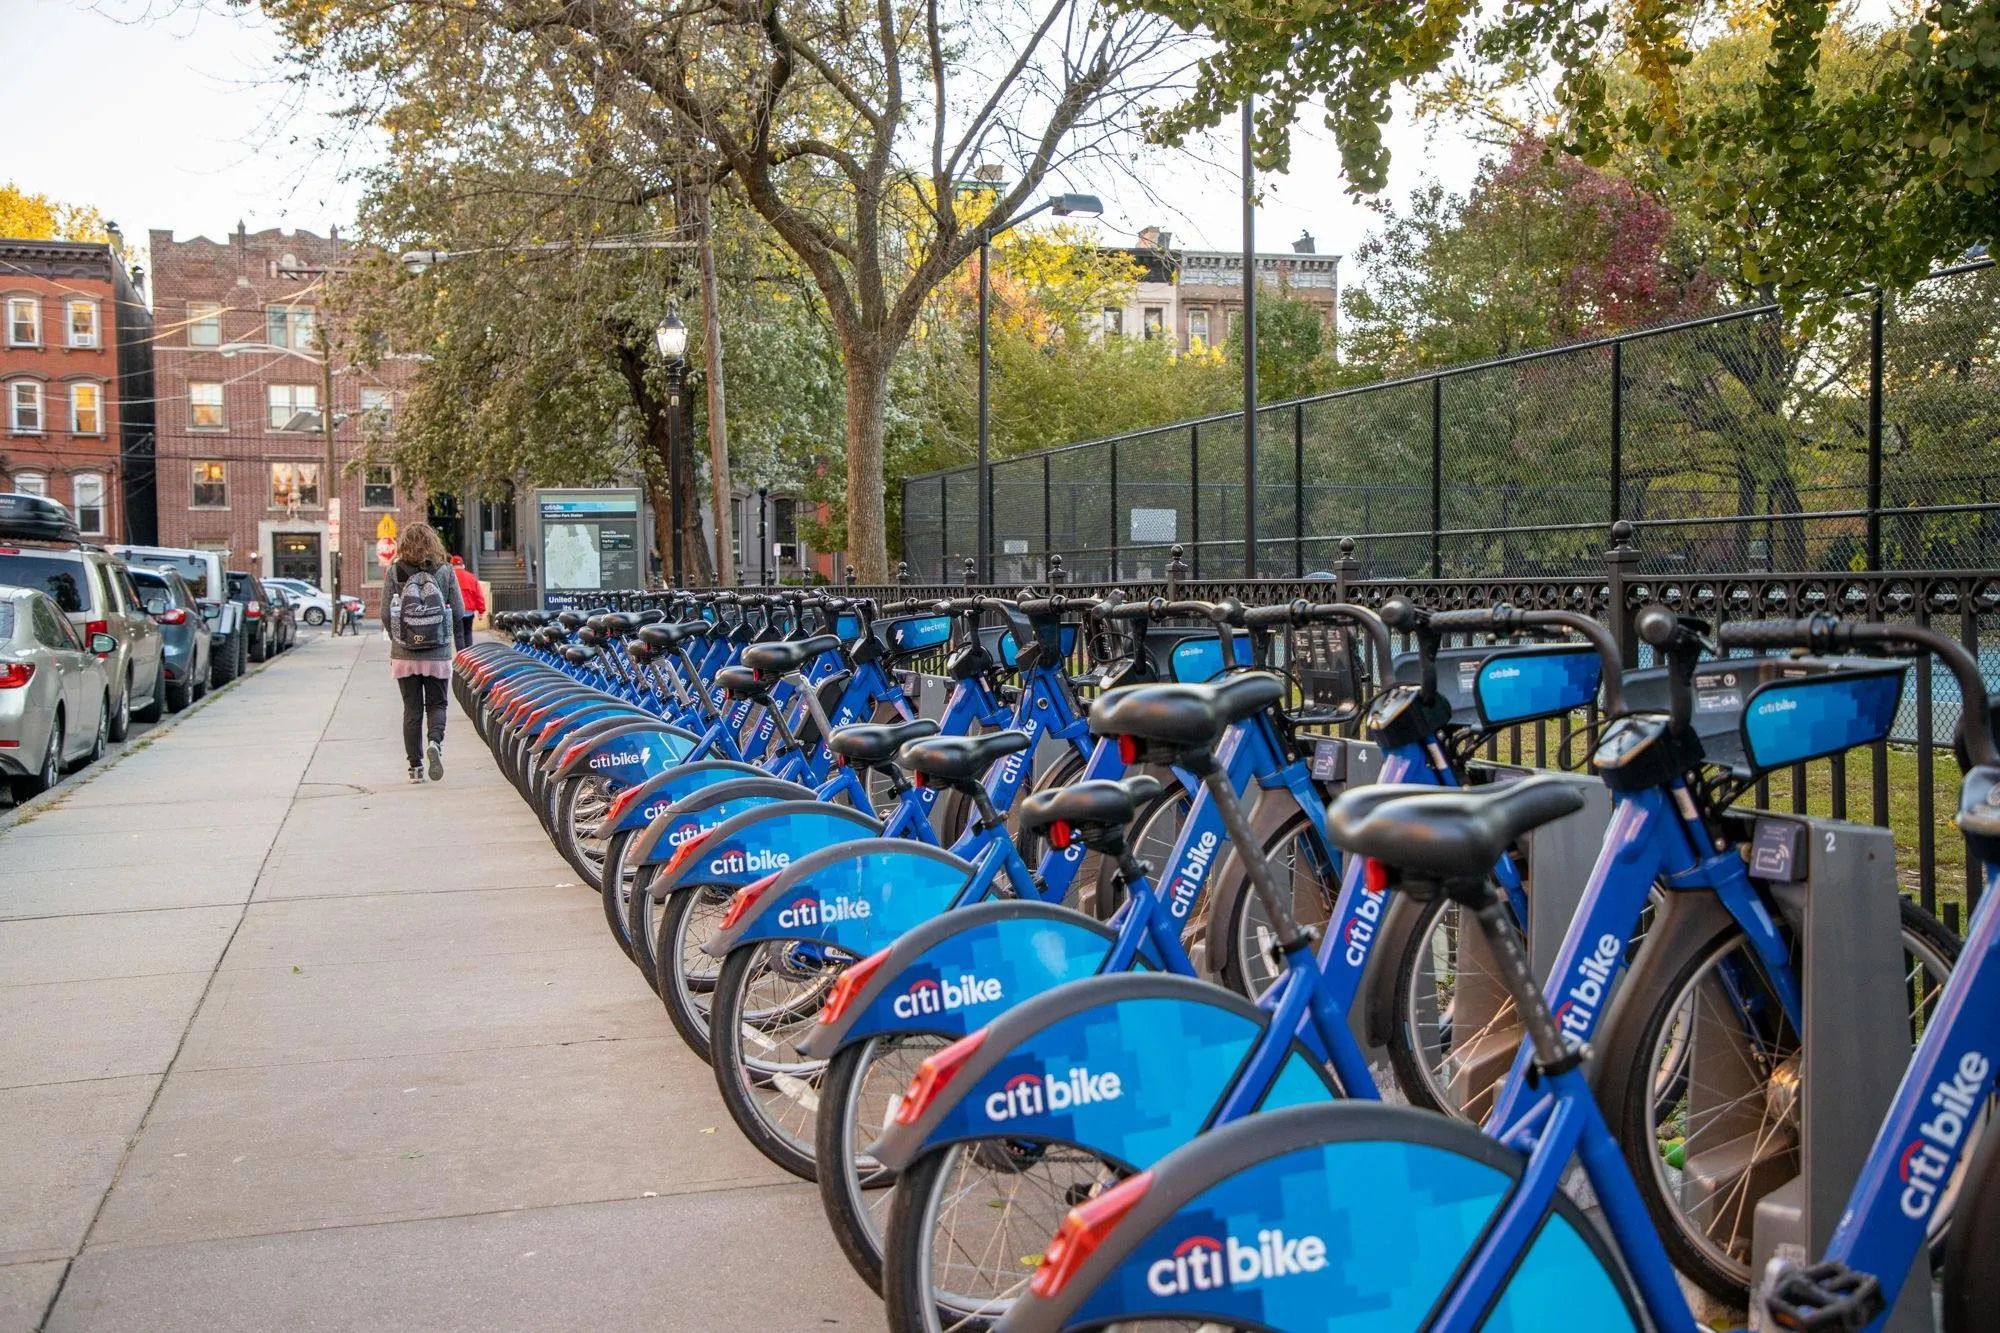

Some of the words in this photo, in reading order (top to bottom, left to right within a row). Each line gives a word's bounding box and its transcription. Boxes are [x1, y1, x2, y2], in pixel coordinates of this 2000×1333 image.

[548, 596, 572, 604] United
[920, 622, 946, 633] electric
[927, 679, 934, 688] 9
[1358, 749, 1368, 763] 4
[1825, 831, 1836, 852] 2
